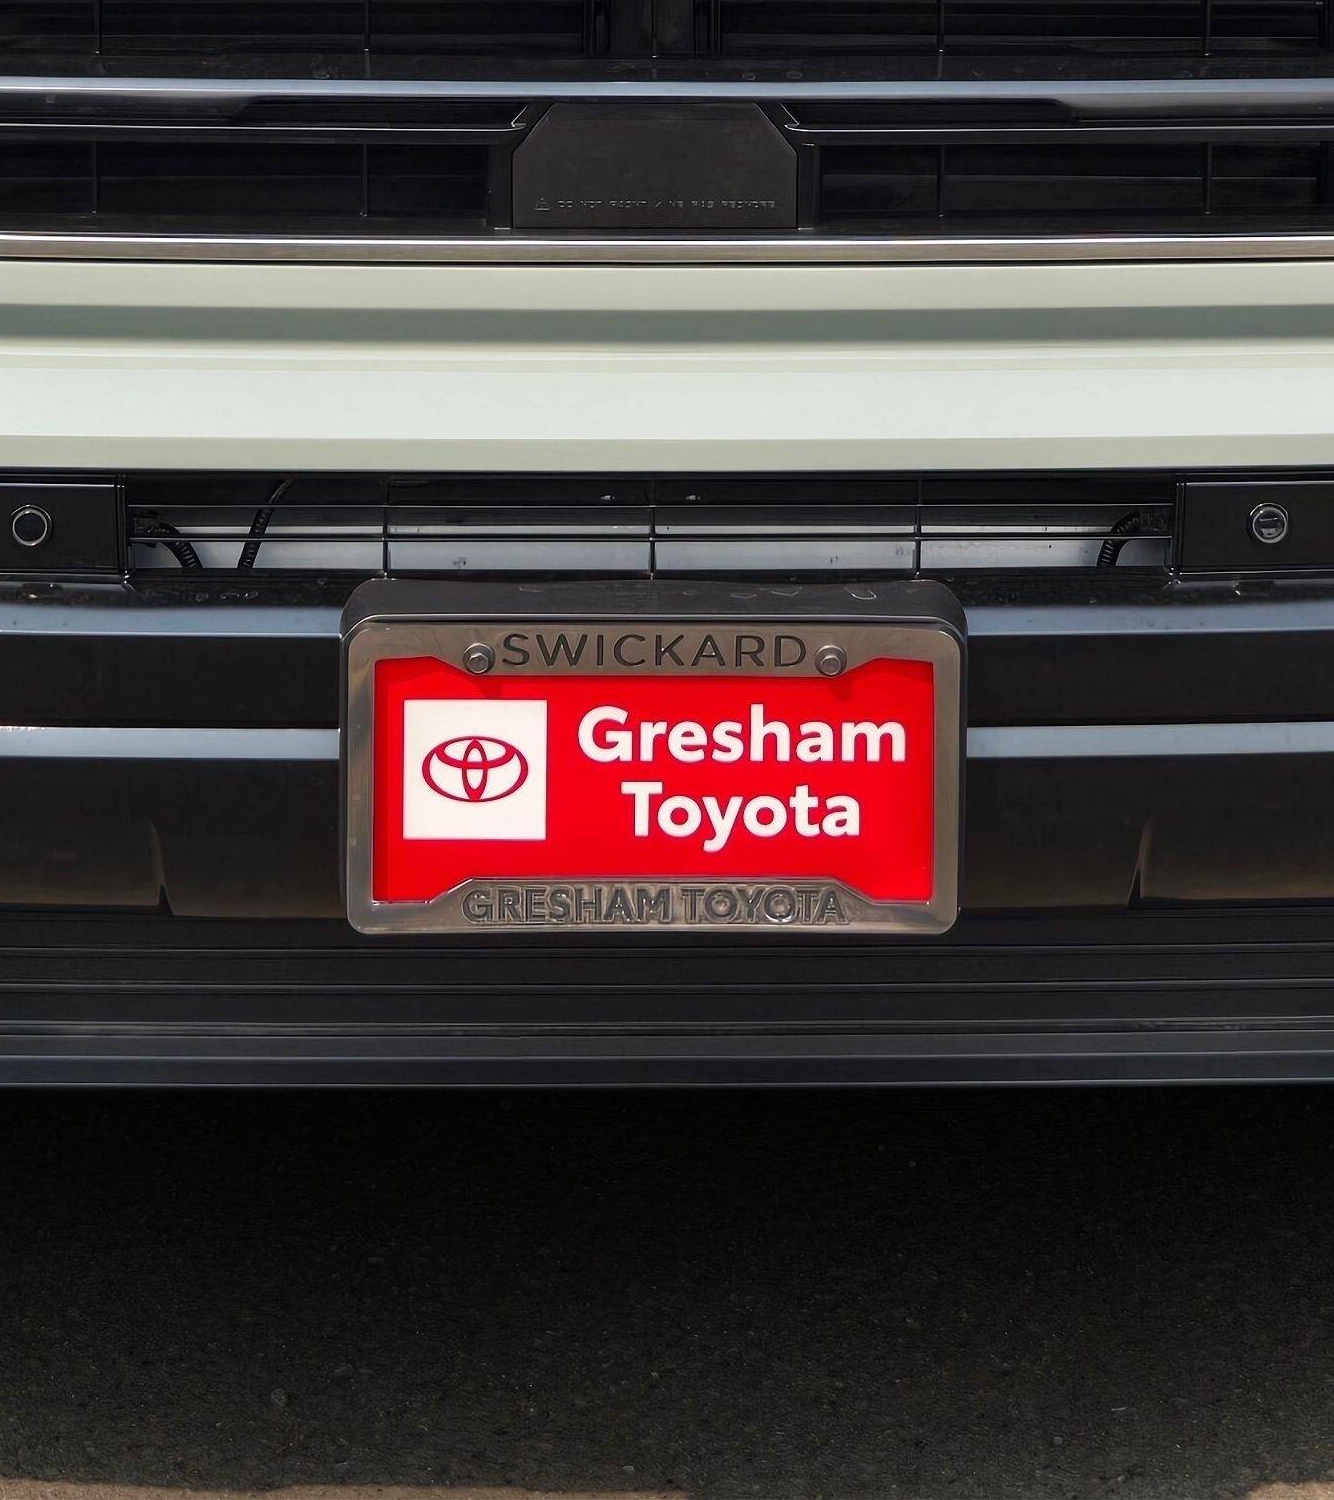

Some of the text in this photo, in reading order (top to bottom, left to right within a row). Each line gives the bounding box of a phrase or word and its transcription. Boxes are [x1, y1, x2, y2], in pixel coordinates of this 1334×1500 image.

[502, 633, 807, 668] SWICKARD
[578, 704, 906, 762] Gresham
[620, 781, 860, 852] Toyota
[463, 885, 850, 925] GRESHAM TOYOTA
